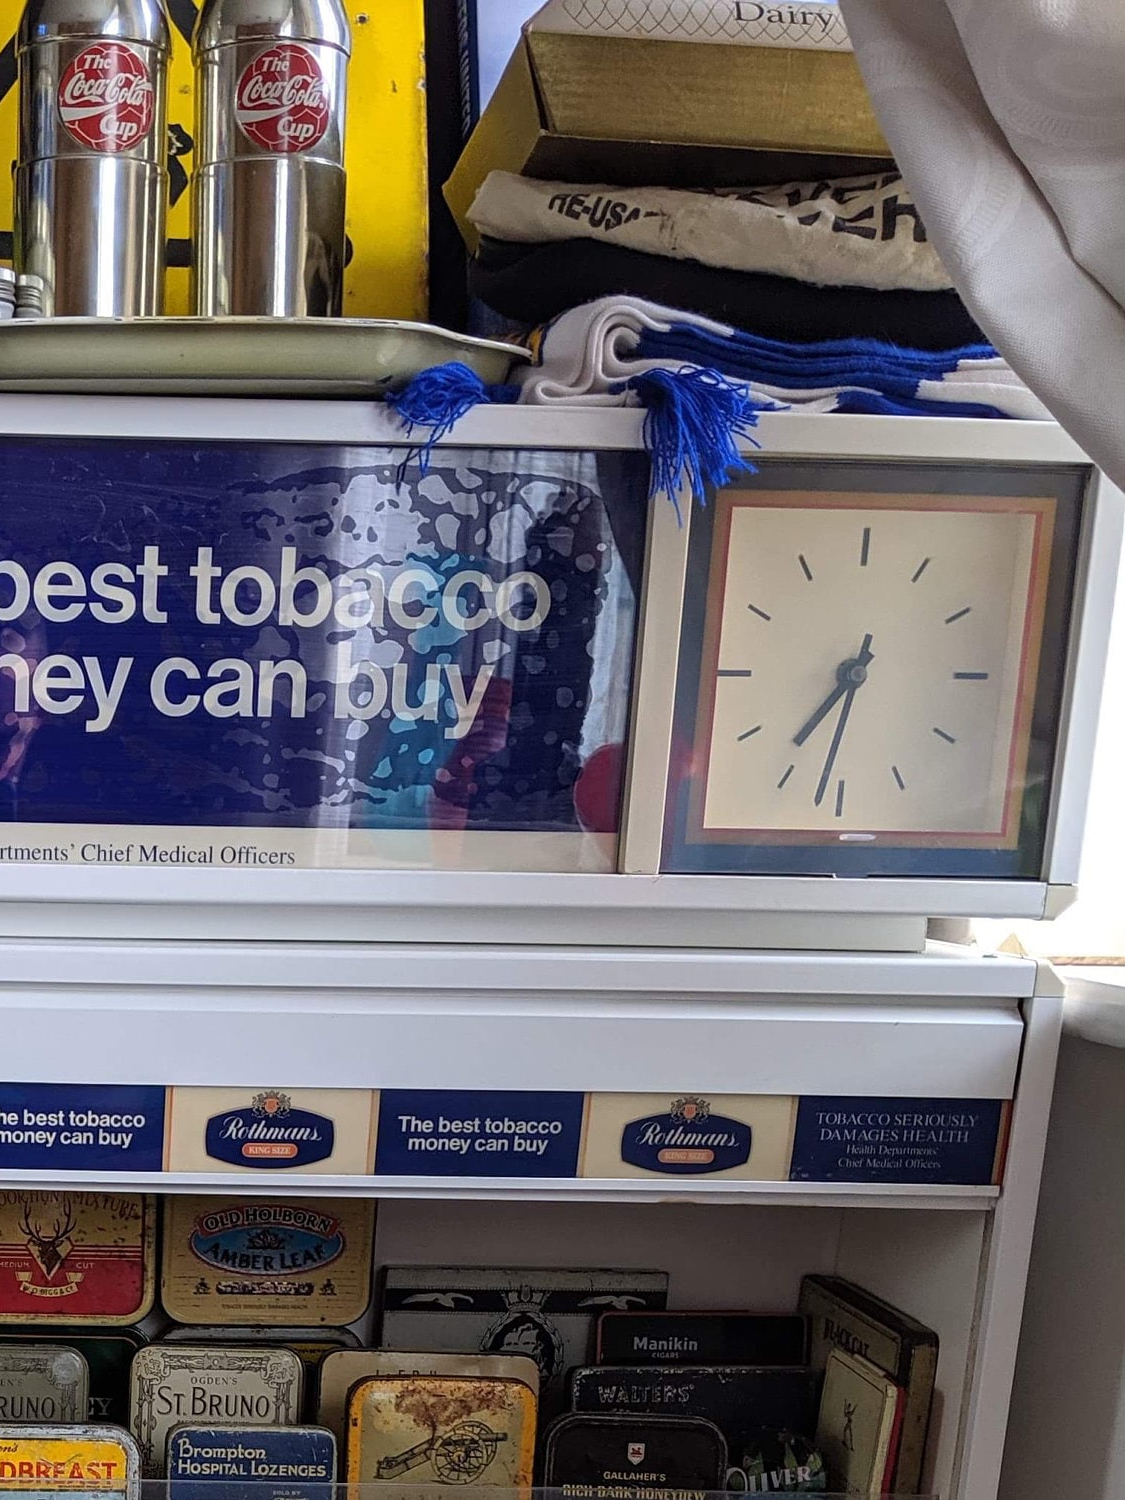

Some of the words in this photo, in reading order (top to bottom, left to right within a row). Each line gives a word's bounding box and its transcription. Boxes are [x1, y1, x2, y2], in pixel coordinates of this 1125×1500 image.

[734, 1, 834, 33] Dairy
[83, 55, 111, 70] The
[262, 56, 289, 71] The
[64, 72, 152, 105] Coca-Cola
[100, 115, 137, 139] Cup
[277, 117, 314, 141] Cup
[190, 547, 551, 633] tobacco
[149, 659, 307, 719] can
[336, 655, 493, 740] buy
[80, 843, 134, 864] Chief
[138, 844, 214, 865] Medical
[220, 845, 295, 866] Officers
[219, 1115, 322, 1142] Rothmans
[816, 1112, 890, 1127] TOBACCO
[894, 1112, 979, 1128] SERIOUSLY
[636, 1122, 739, 1147] Rothmans
[820, 1128, 899, 1142] DAMAGES
[903, 1129, 968, 1143] HEALTH
[204, 1211, 240, 1231] OLD
[245, 1206, 332, 1233] HOLBORN
[634, 1336, 698, 1351] Manikin
[178, 1438, 266, 1461] Brompton
[178, 1460, 247, 1475] HOSPITAL
[251, 1462, 326, 1477] LOZENGES
[603, 1471, 666, 1482] GALLAHER'S
